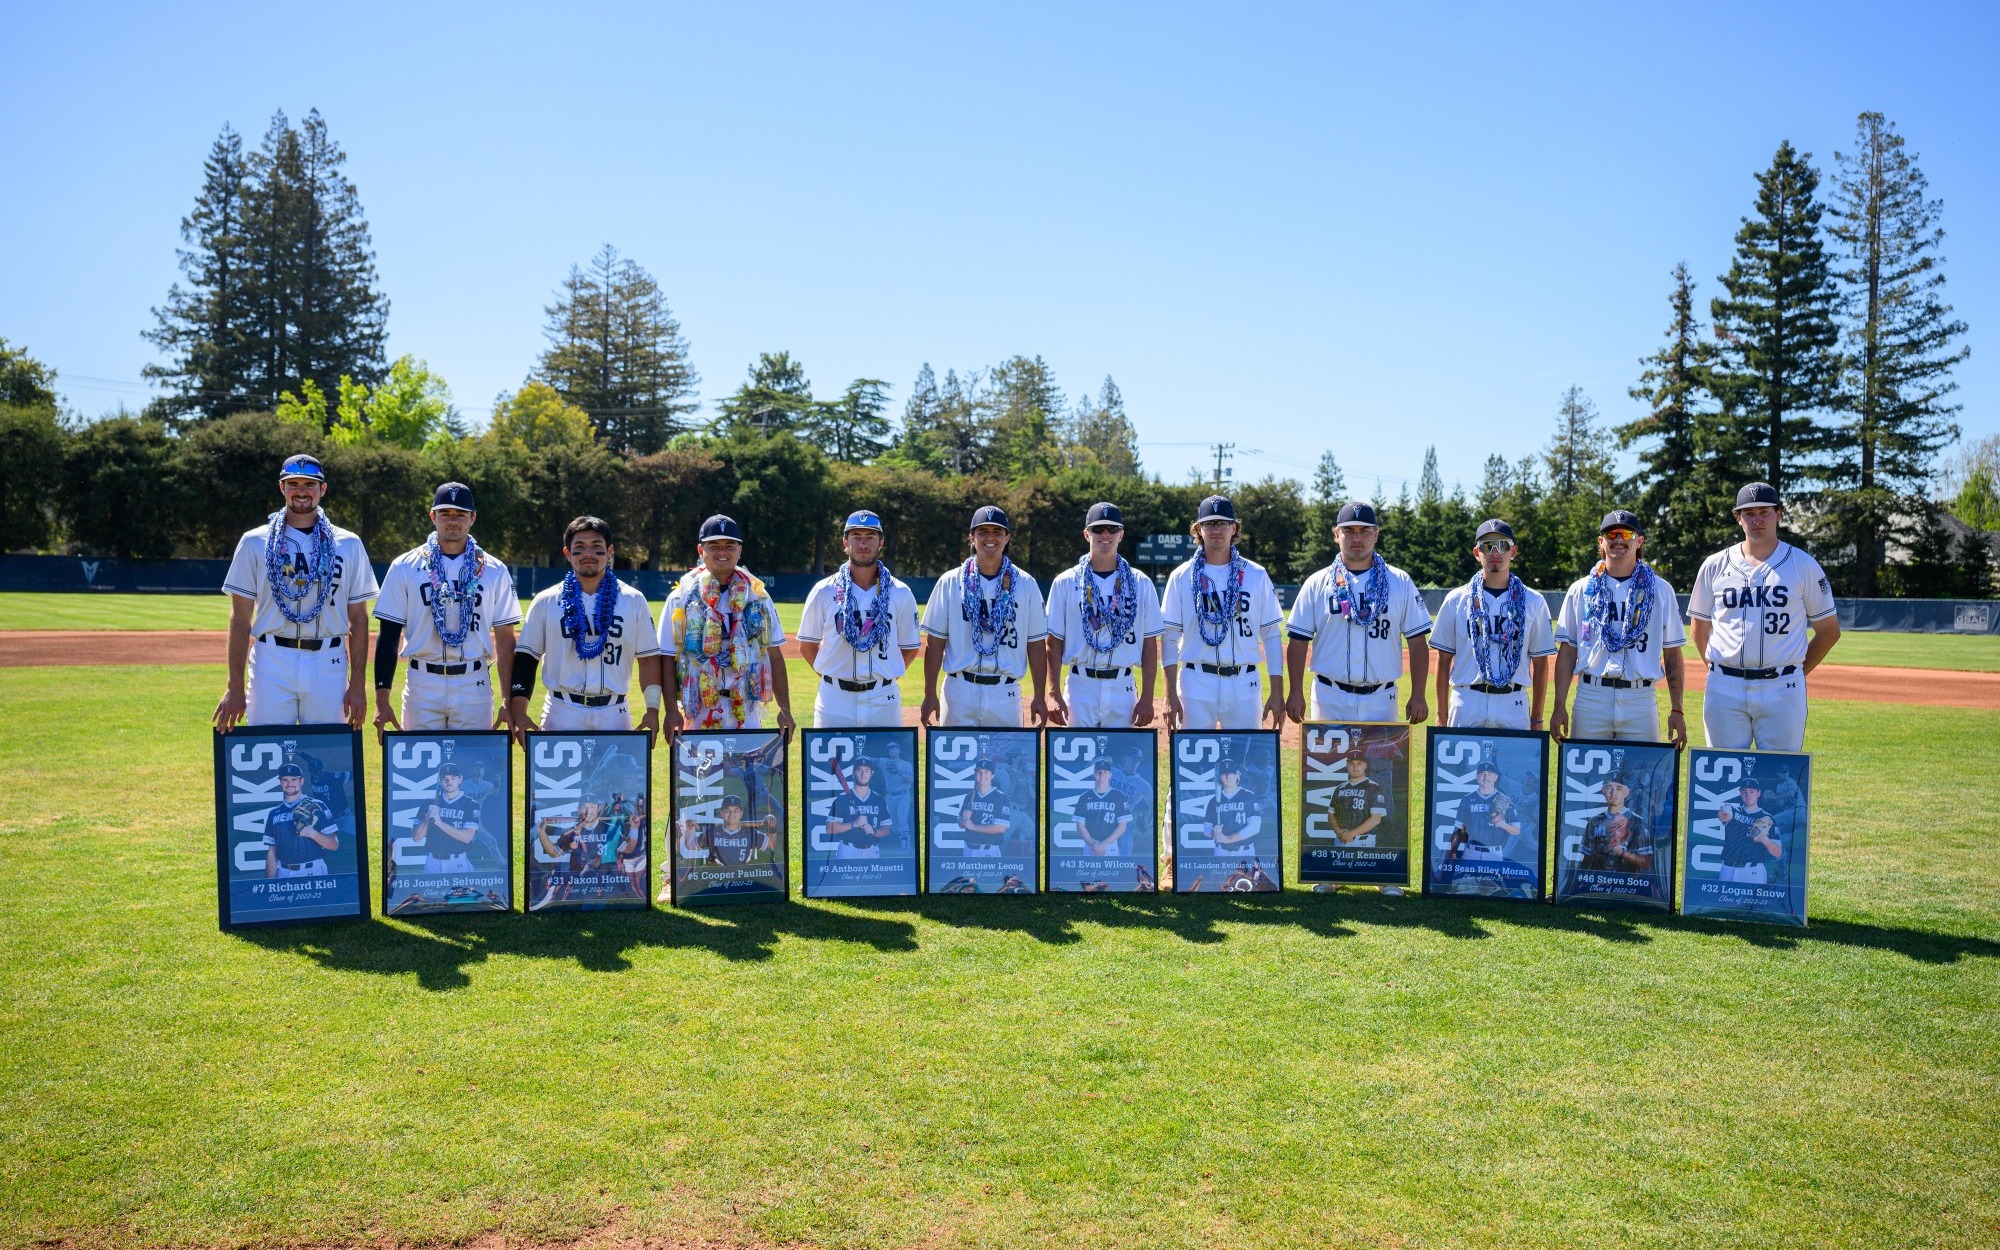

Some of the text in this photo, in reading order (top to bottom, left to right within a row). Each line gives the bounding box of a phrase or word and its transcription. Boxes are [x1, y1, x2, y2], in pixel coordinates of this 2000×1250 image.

[1158, 534, 1182, 544] OAKS
[758, 576, 774, 587] 70
[1722, 586, 1788, 608] OAKS
[1236, 616, 1253, 638] 13
[1764, 612, 1790, 634] 32
[1368, 618, 1390, 640] 38
[1000, 626, 1018, 649] 23
[604, 643, 622, 666] 31
[1338, 789, 1365, 798] MENLO
[1087, 802, 1115, 811] MENLO
[1352, 798, 1365, 809] 38
[1470, 804, 1490, 812] MEN
[272, 813, 294, 824] MEN
[1104, 812, 1116, 824] 43
[1235, 813, 1247, 824] 41
[1734, 812, 1754, 824] MEN
[714, 838, 748, 847] MENLO
[597, 844, 607, 856] 31
[739, 849, 746, 861] 5
[1331, 851, 1354, 860] Tyler
[1357, 852, 1397, 860] Kennedy
[832, 865, 868, 874] Anthony
[998, 863, 1023, 871] Leong
[1454, 864, 1475, 873] Sean
[1477, 865, 1500, 875] Riley
[1502, 868, 1529, 876] Moran
[548, 875, 630, 885] #31 Jaxon Hotta
[688, 869, 773, 880] #5 Cooper Paulino
[413, 879, 450, 888] Joseph
[452, 876, 504, 887] Selvaggio
[1597, 876, 1624, 885] Steve
[1627, 878, 1649, 886] Soto
[252, 880, 337, 894] #7 Richard Kiel
[1701, 884, 1785, 898] #32 Logan Snow
